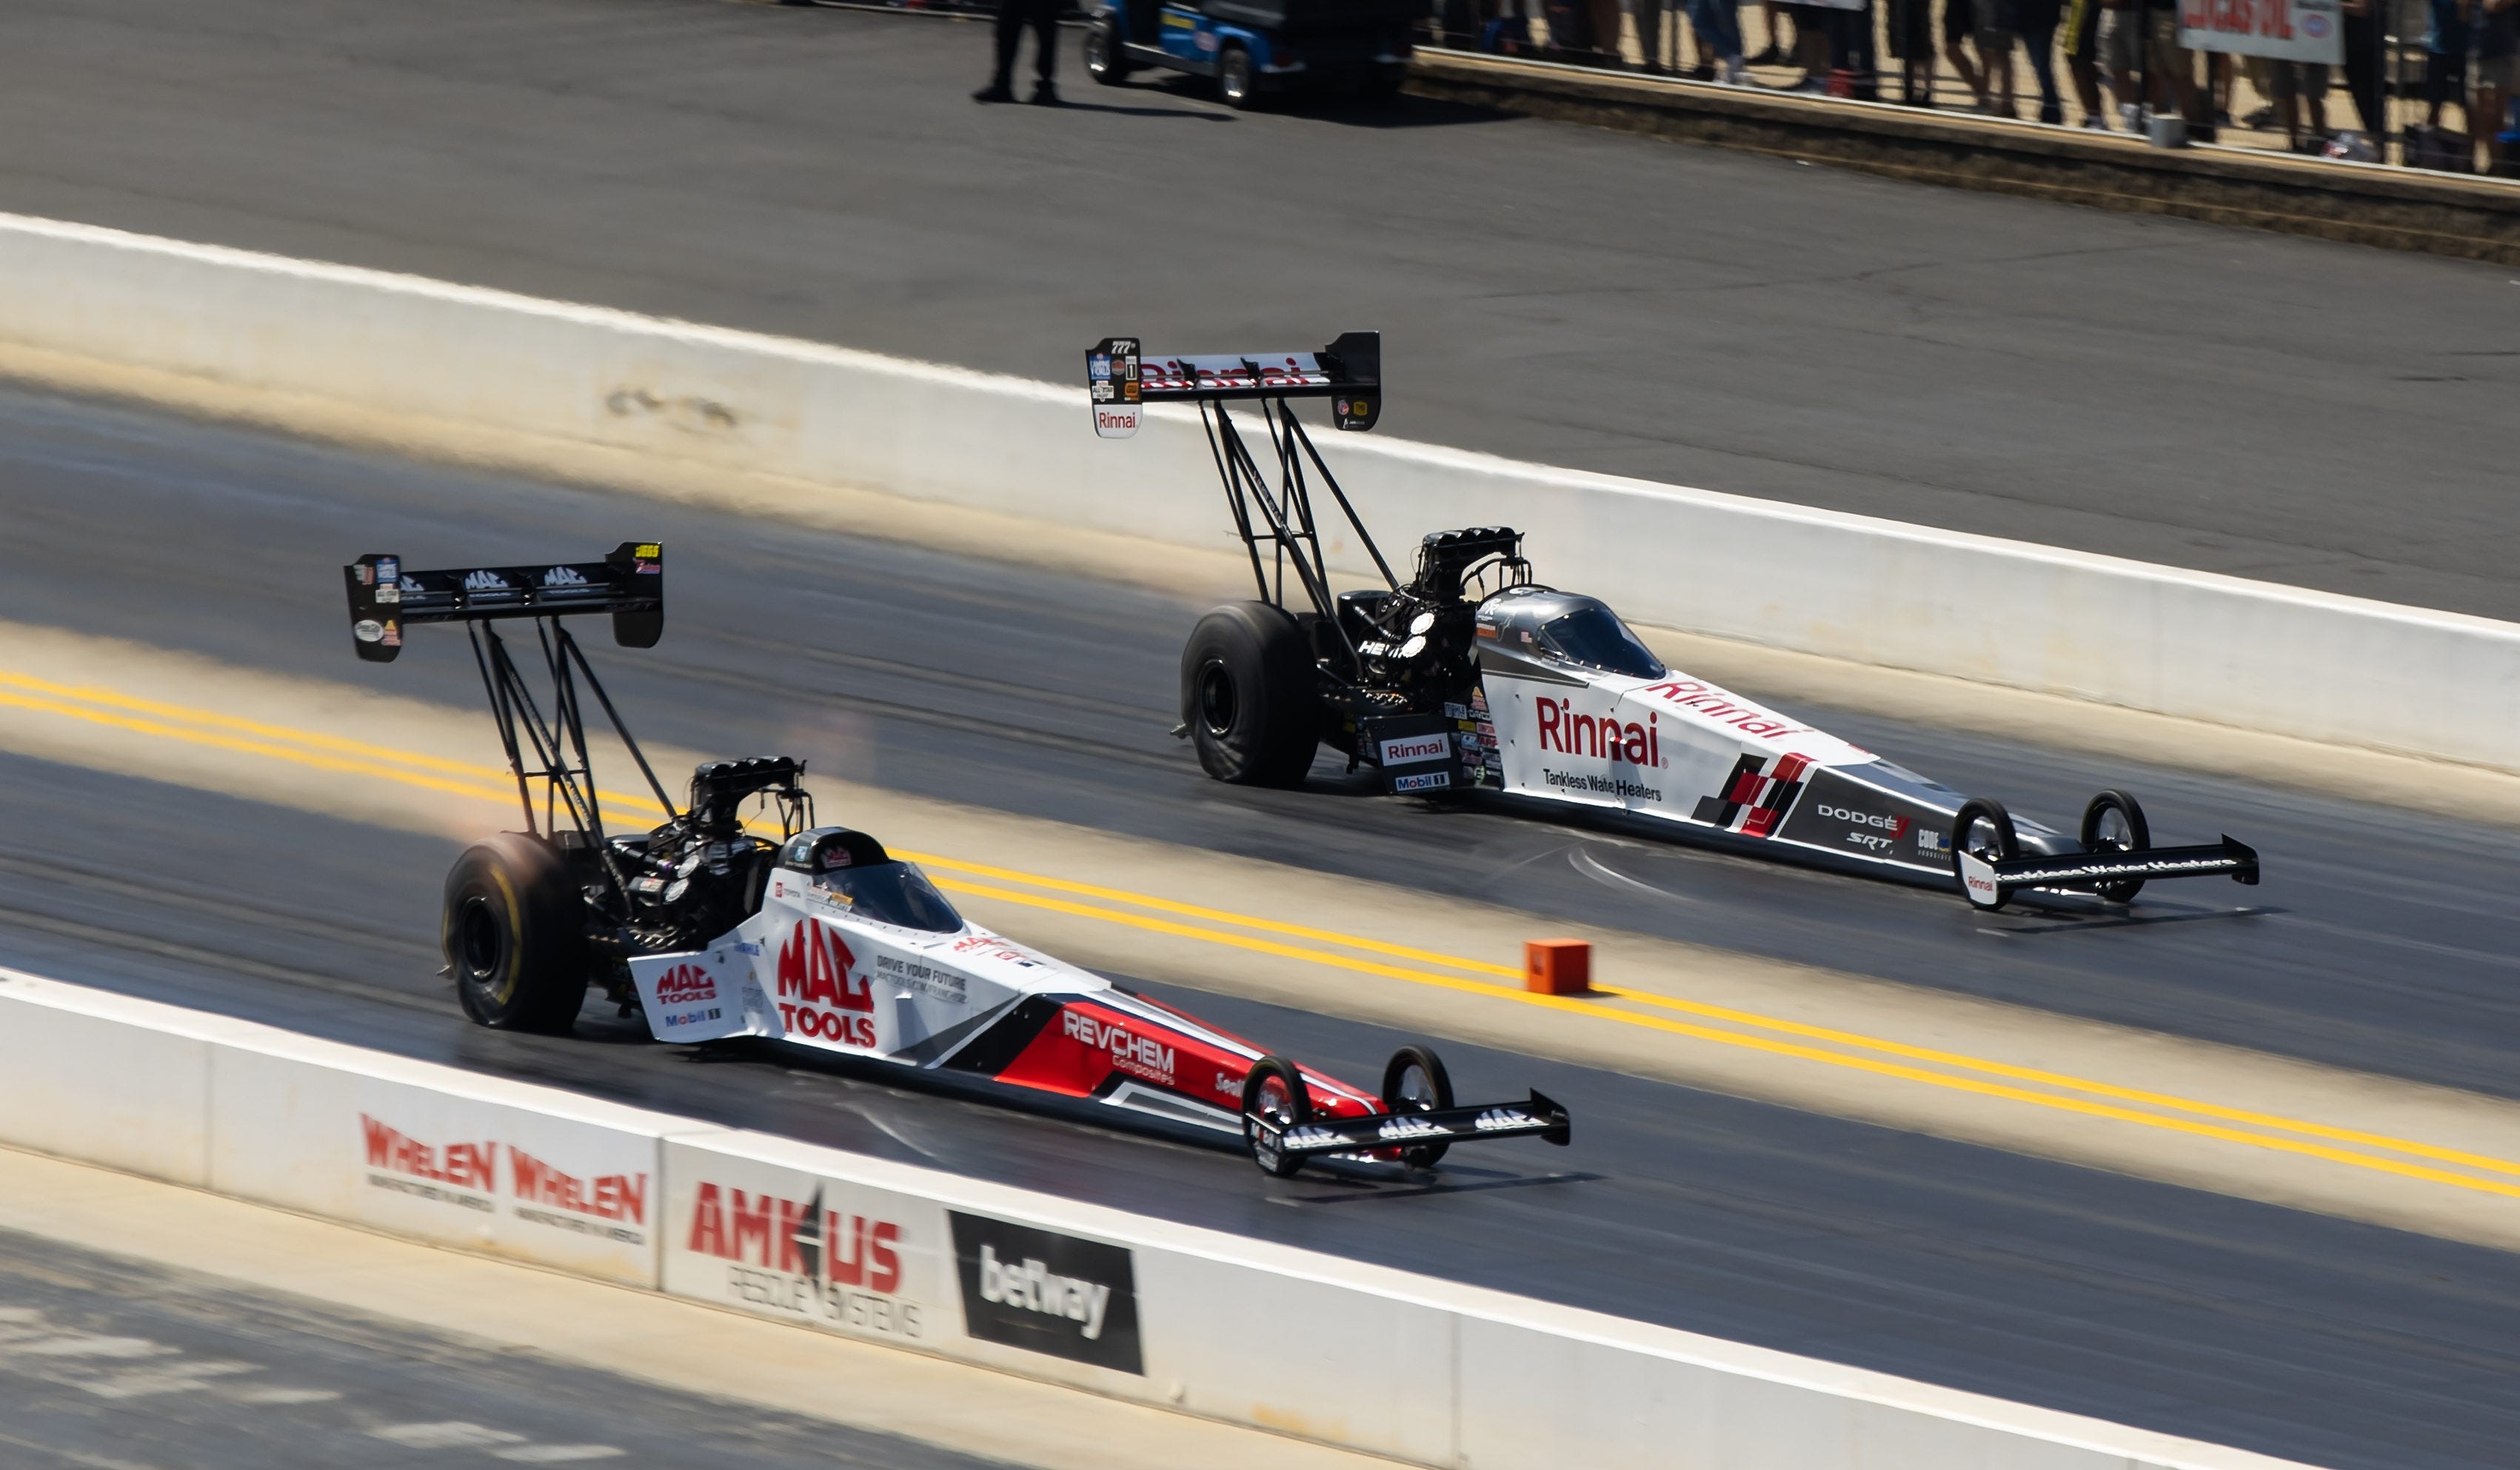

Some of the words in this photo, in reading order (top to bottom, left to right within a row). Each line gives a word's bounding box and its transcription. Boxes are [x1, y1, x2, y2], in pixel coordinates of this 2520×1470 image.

[1112, 341, 1132, 354] 777
[1099, 412, 1136, 428] Rinnai
[464, 570, 509, 589] MAC
[544, 566, 588, 586] MAC
[1644, 681, 1815, 739] Rinnai
[1536, 697, 1659, 768] Rinnai
[1388, 739, 1443, 759] Rinnai
[1397, 775, 1432, 789] Mobil
[1543, 769, 1588, 790] Tankless
[1587, 775, 1616, 794] Wate
[1616, 780, 1662, 802] Heaters
[1817, 804, 1898, 831] DODGE
[1846, 832, 1894, 850] SRT
[1968, 876, 1993, 892] Rinnai
[657, 963, 715, 995] MAC
[777, 918, 874, 1014] MAC
[877, 955, 904, 973] DRIVE
[905, 962, 932, 980] YOUR
[932, 969, 966, 991] FUTURE
[657, 989, 717, 1005] TOOLS
[665, 1010, 706, 1027] Mobil
[778, 1002, 877, 1049] TOOLS
[1063, 1010, 1174, 1075] REVCHEM
[1112, 1055, 1175, 1086] Composites
[979, 1243, 1111, 1341] betway
